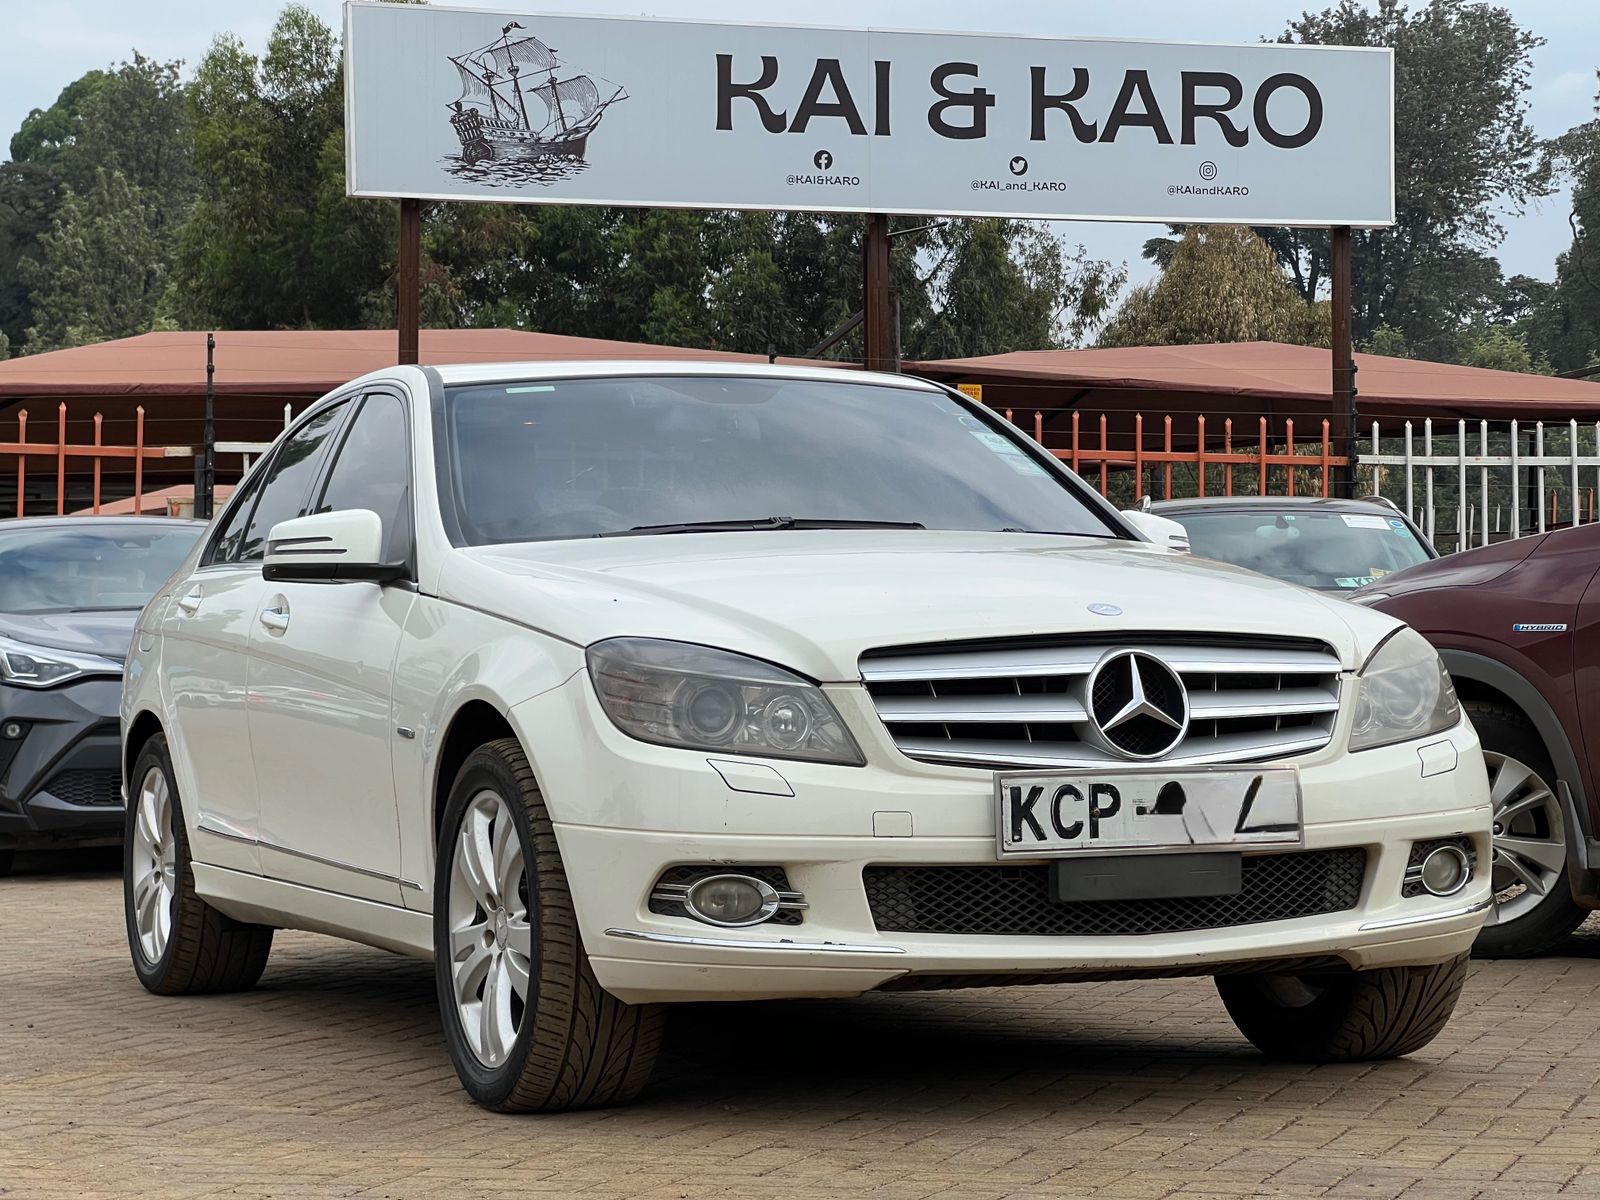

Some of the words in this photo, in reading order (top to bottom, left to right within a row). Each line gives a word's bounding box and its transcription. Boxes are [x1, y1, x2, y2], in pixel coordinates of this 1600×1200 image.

[716, 53, 891, 137] KAI
[927, 62, 996, 140] &
[1029, 66, 1324, 149] KARO
[786, 174, 860, 186] @KAI&KARO
[970, 180, 1067, 192] @KAI_and_KARO
[1166, 185, 1250, 196] @KAIandKARO
[1009, 783, 1122, 843] KCP
